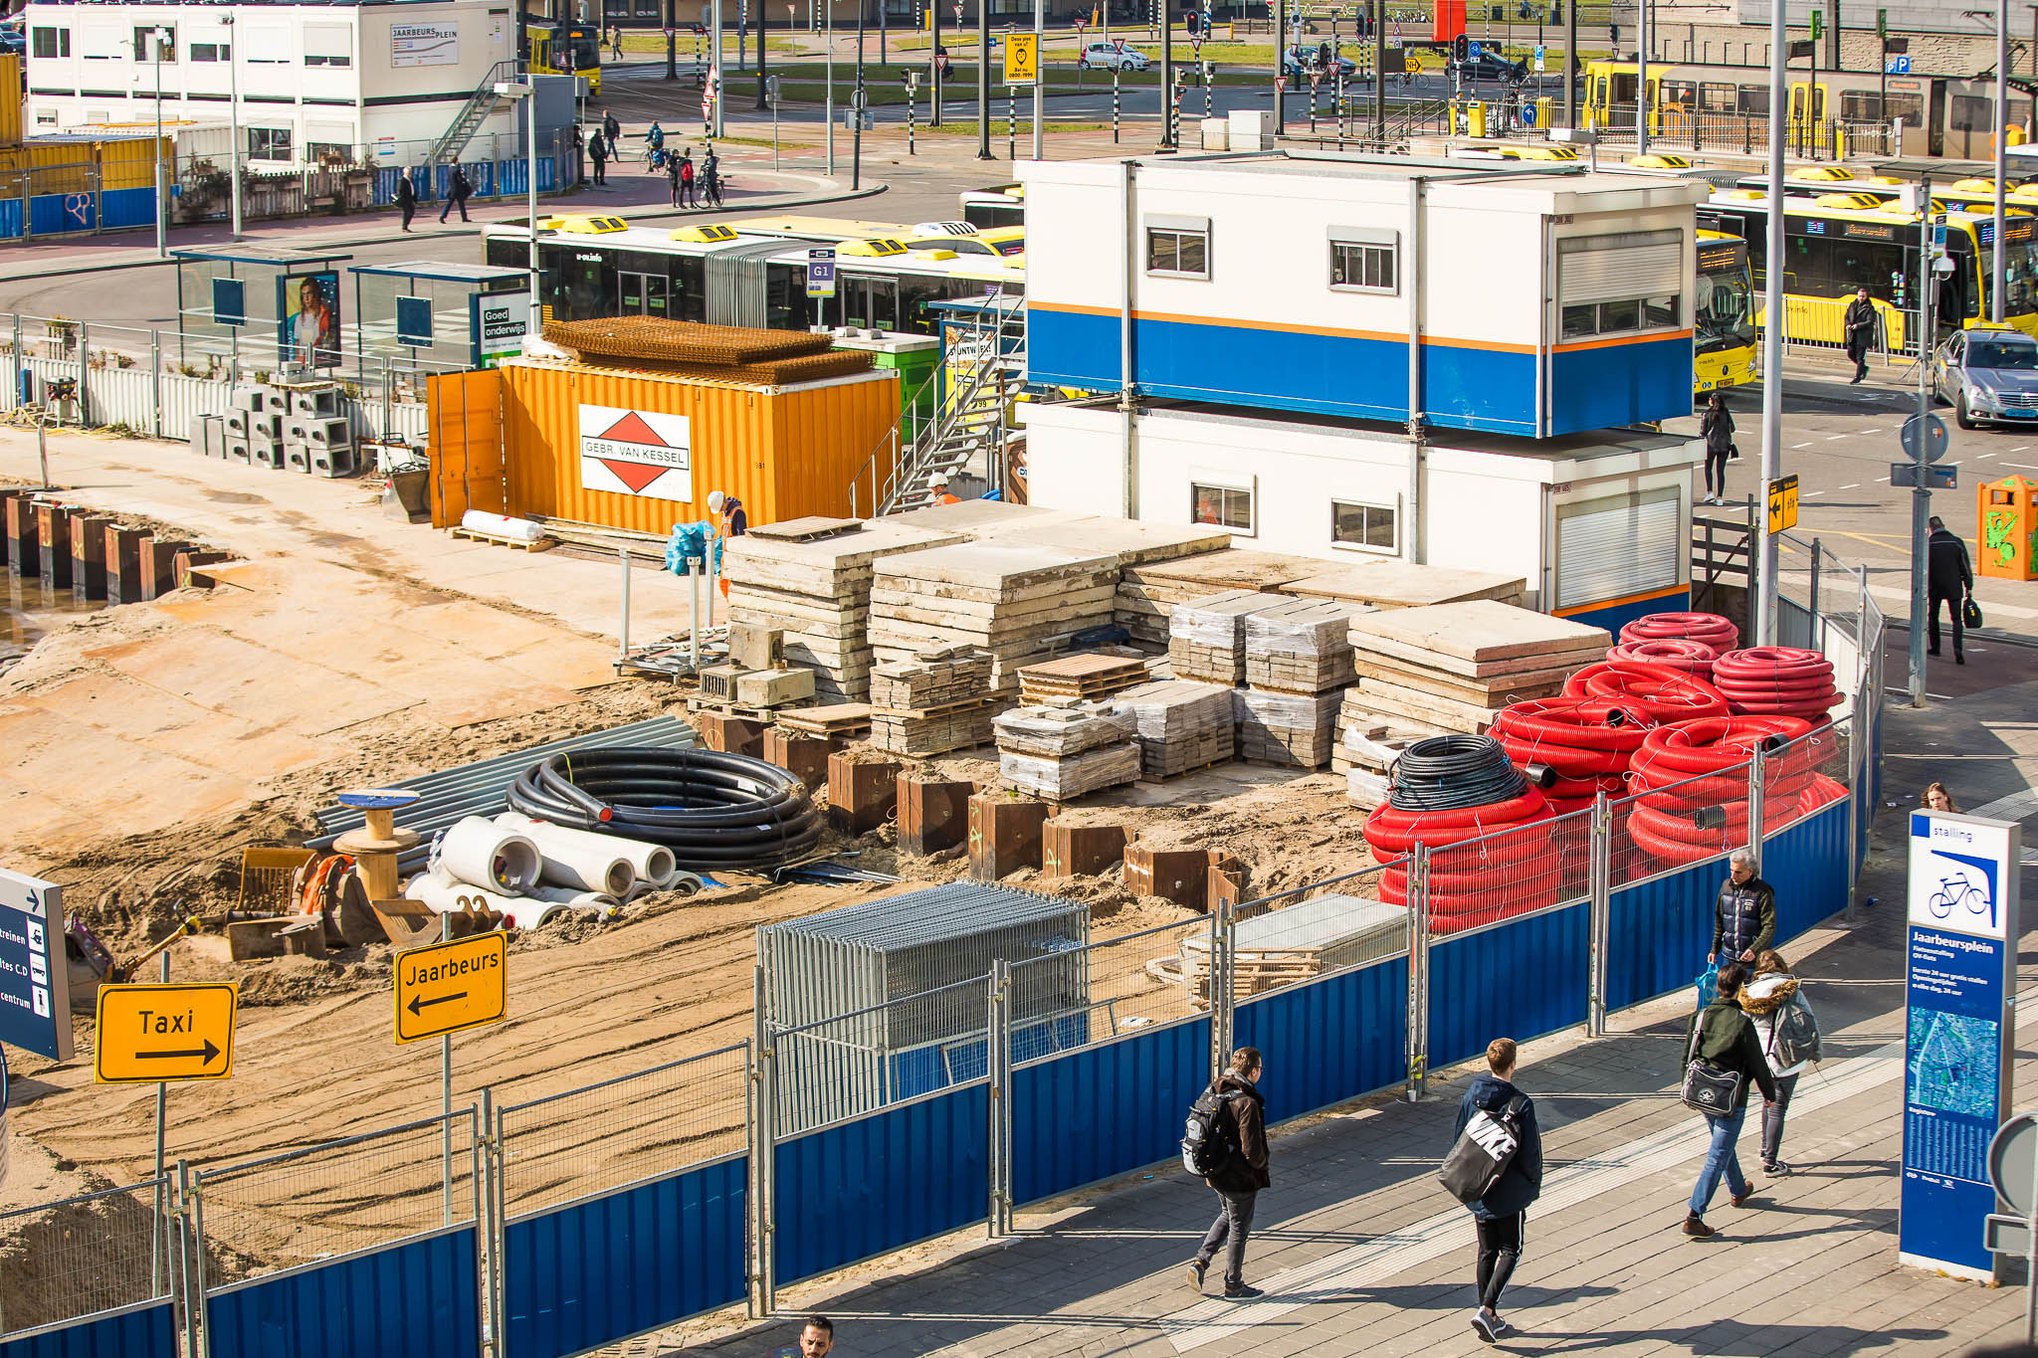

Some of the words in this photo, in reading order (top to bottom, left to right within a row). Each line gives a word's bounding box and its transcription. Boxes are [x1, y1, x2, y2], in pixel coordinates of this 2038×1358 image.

[1406, 59, 1416, 69] NH
[1900, 58, 1907, 71] P
[814, 266, 828, 276] G1
[485, 310, 508, 320] Goed
[486, 324, 525, 337] onderwijs
[586, 442, 616, 454] GEBR.
[620, 447, 639, 457] VAN
[643, 449, 684, 463] KESSEL
[1934, 827, 1973, 842] stalling
[1913, 931, 1994, 954] Jaarbeursplein
[406, 953, 499, 986] Jaarbeurs
[0, 991, 31, 1010] centrum
[139, 1010, 193, 1034] Taxi
[1465, 1110, 1517, 1162] NIKE
